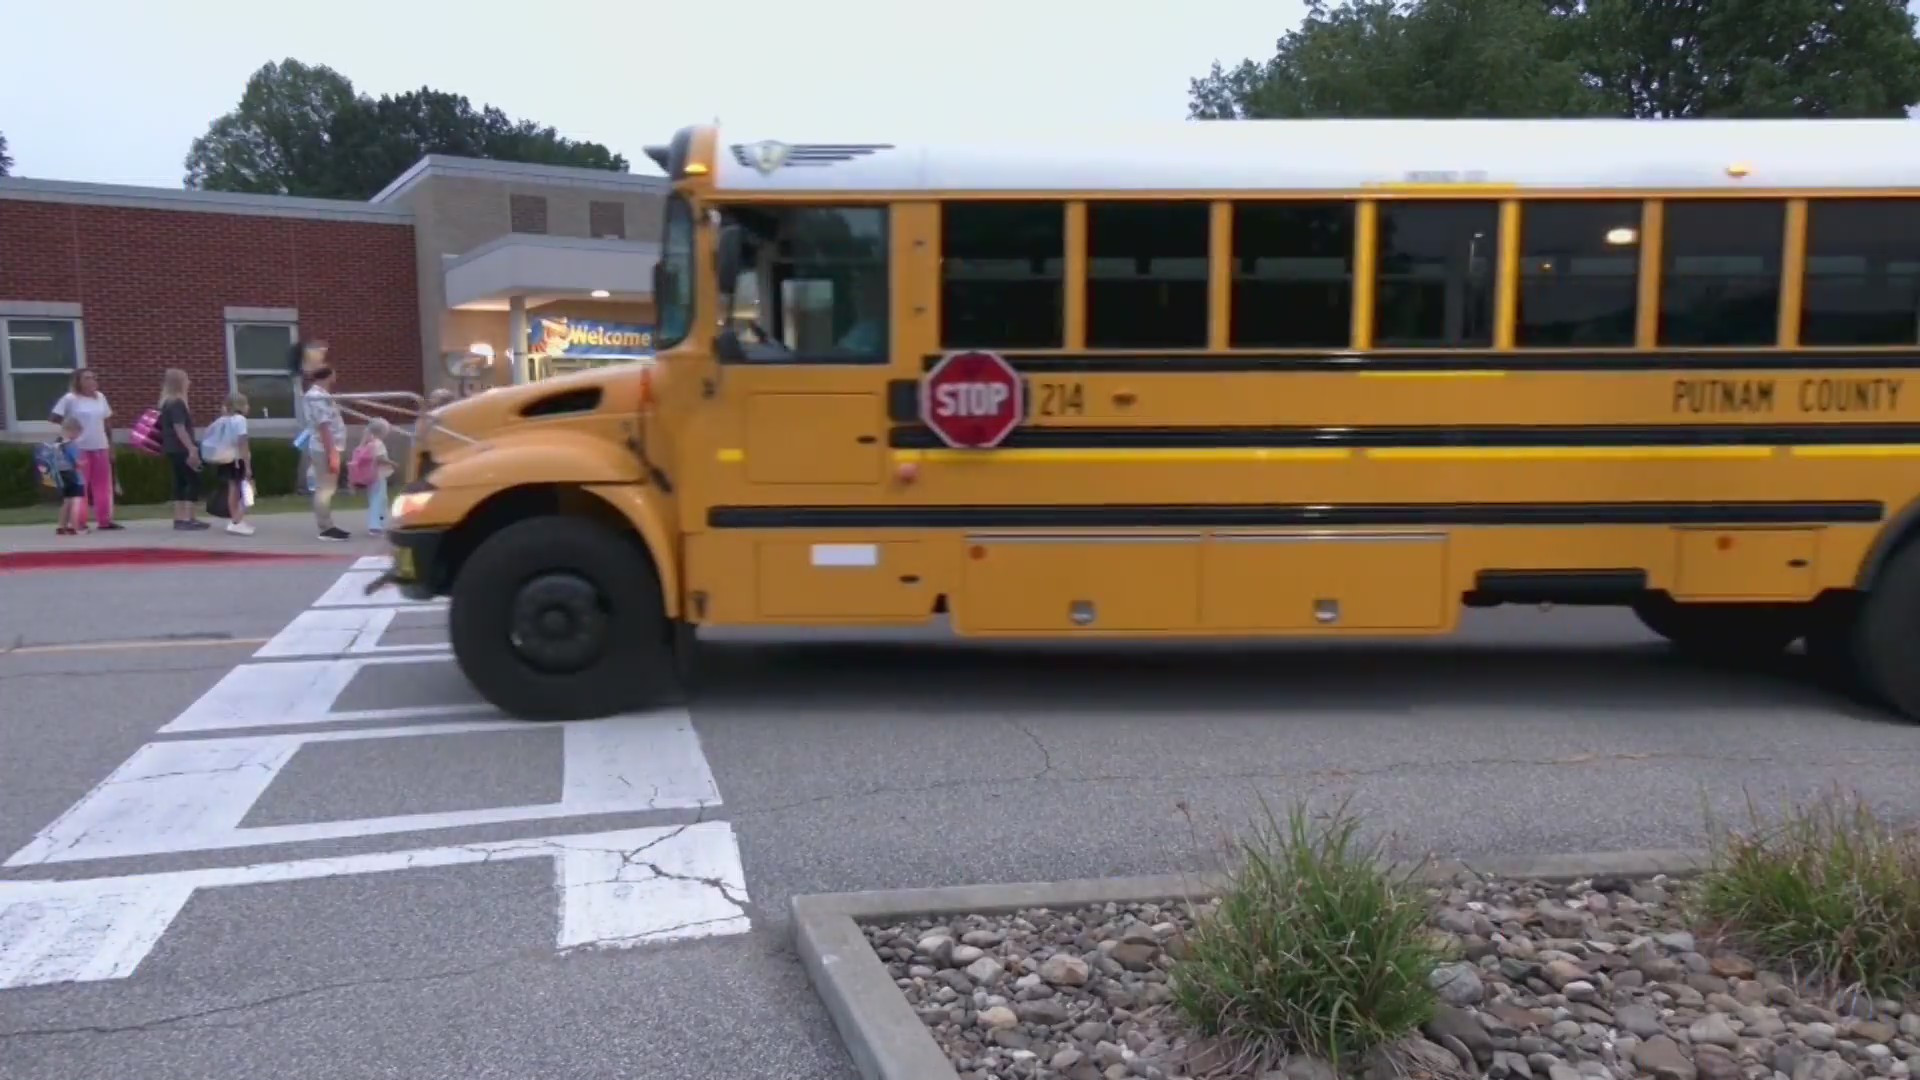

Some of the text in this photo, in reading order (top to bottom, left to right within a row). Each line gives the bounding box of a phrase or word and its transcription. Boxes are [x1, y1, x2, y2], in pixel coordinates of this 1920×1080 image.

[569, 323, 651, 346] Welcome
[935, 382, 1009, 417] STOP
[1040, 384, 1084, 416] 214
[1673, 378, 1903, 413] PUTNAM COUNTY
